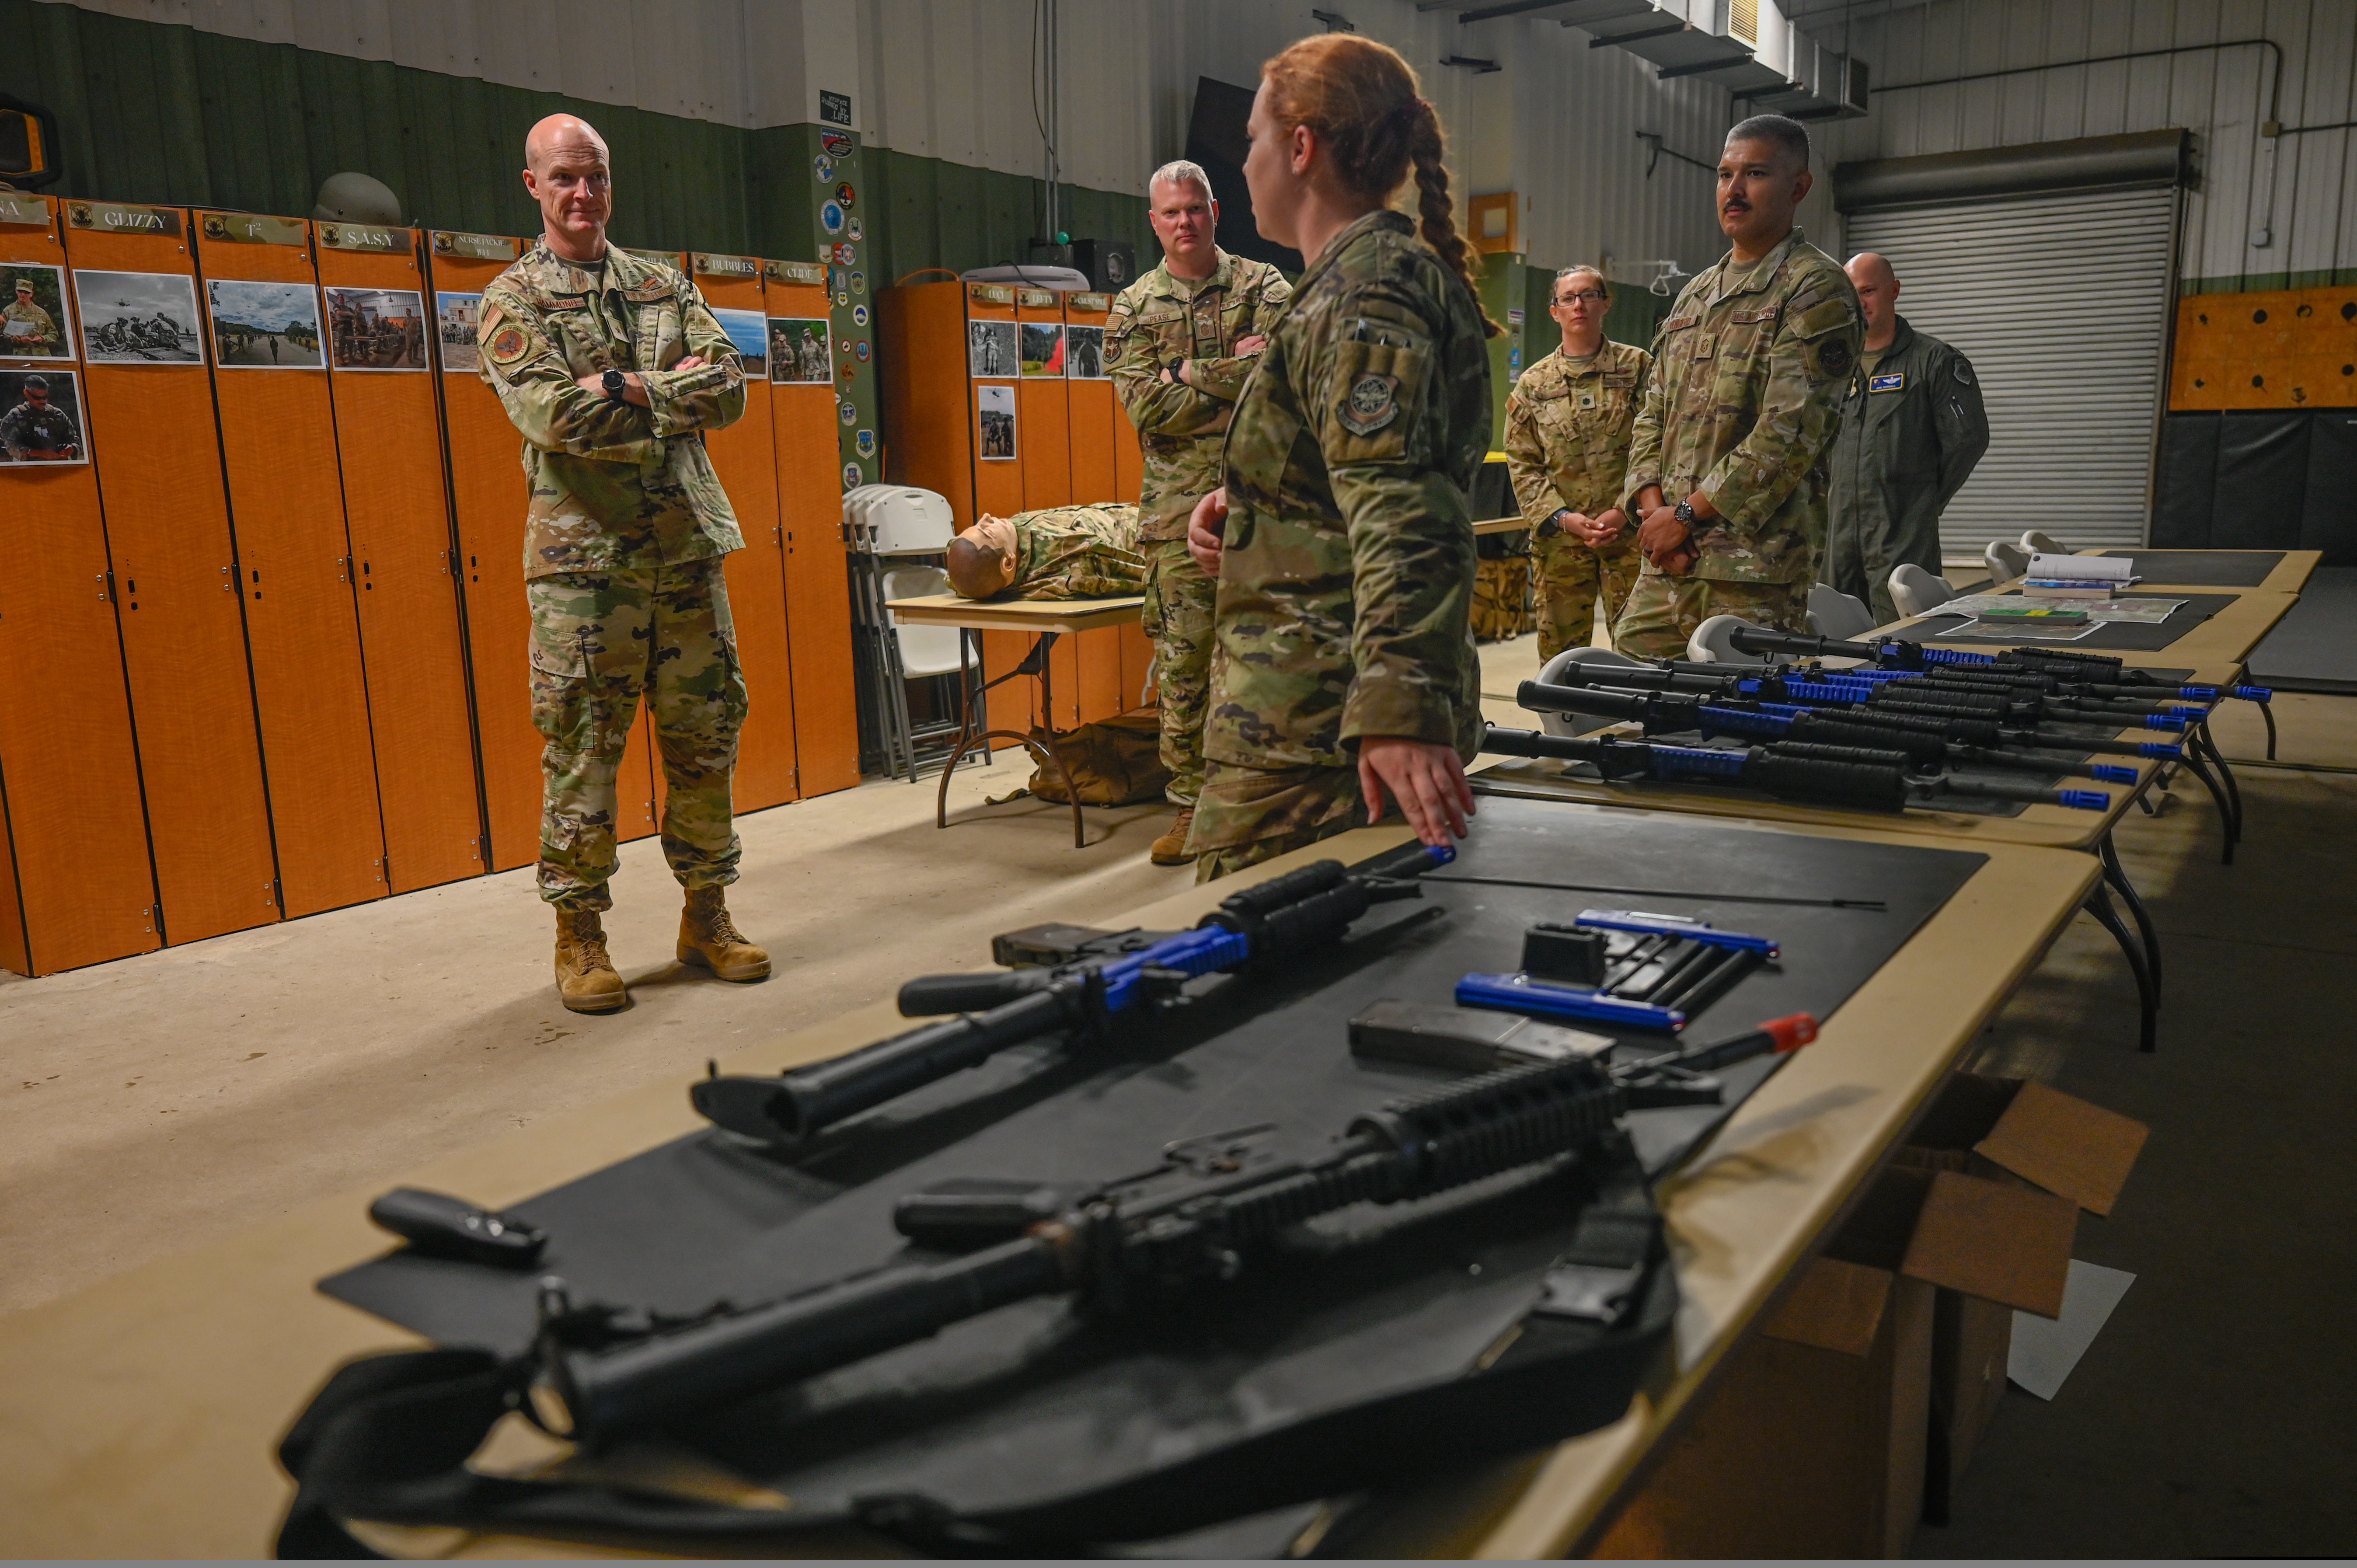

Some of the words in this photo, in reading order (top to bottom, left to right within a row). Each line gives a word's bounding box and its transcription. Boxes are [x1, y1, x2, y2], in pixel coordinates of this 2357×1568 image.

[833, 110, 849, 124] LIFE
[105, 212, 166, 229] GLIZZY
[347, 231, 394, 247] S.A.S.Y
[459, 236, 481, 244] NURSE
[481, 238, 504, 247] JACKIE
[712, 259, 754, 272] BUBBLES
[787, 268, 813, 279] CLIDE
[989, 290, 1004, 299] LUCI
[1032, 295, 1053, 304] LEFTY
[537, 298, 578, 308] HAMMOND
[1150, 313, 1170, 323] PEASE
